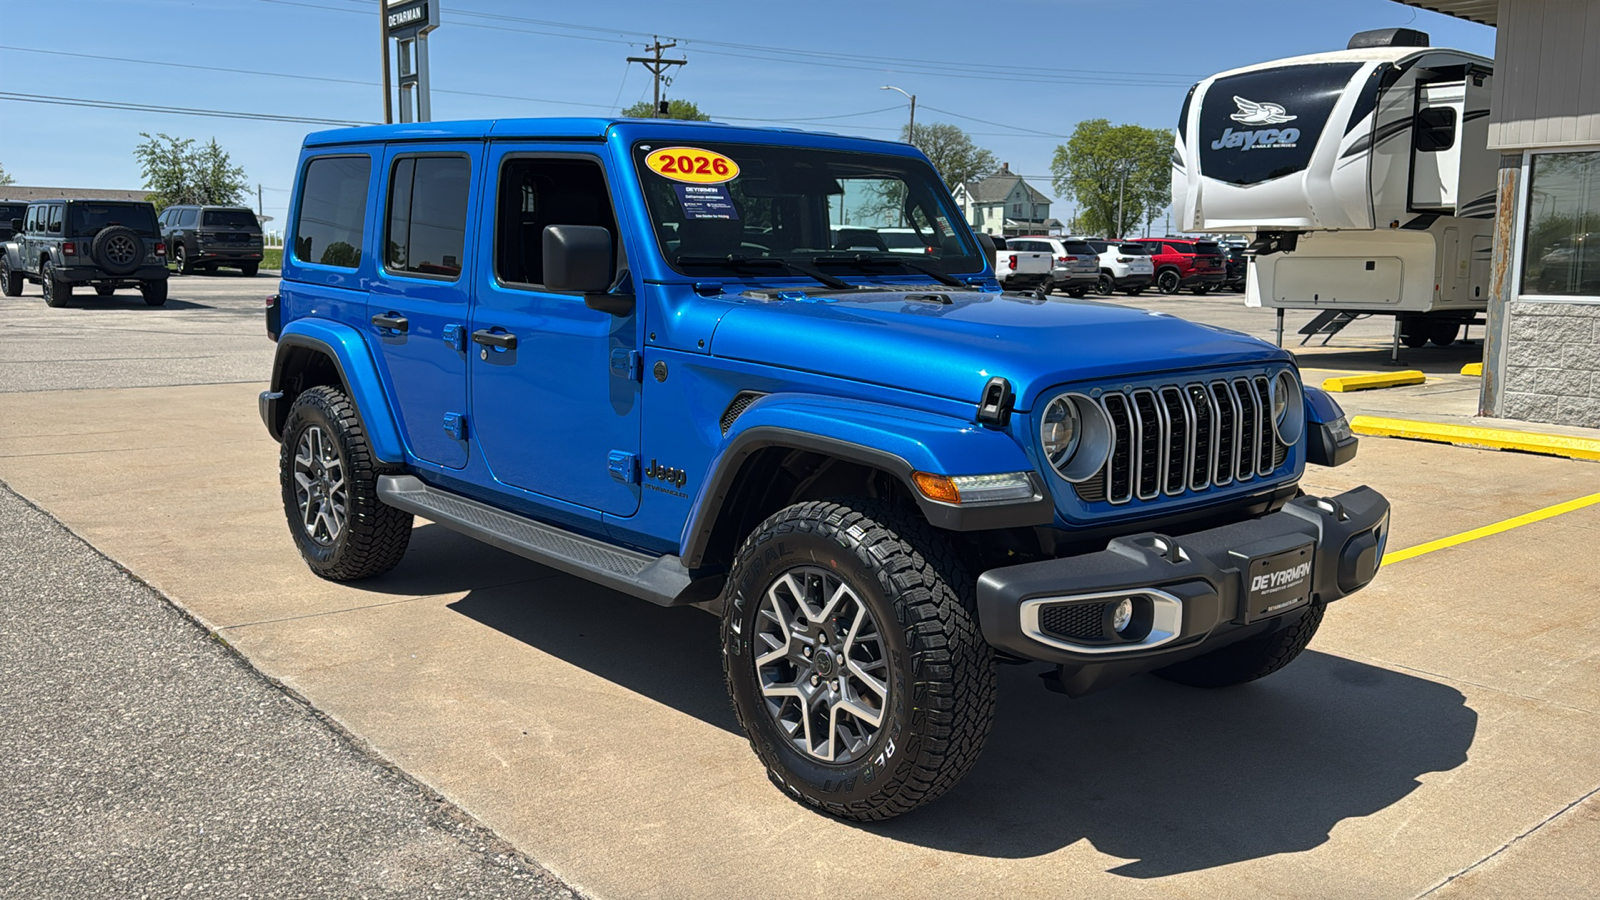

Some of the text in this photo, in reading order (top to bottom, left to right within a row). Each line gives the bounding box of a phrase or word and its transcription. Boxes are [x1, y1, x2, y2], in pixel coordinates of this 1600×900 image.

[388, 6, 421, 27] DEYARMAN
[1211, 127, 1300, 152] Jayco
[659, 155, 729, 176] 2026
[645, 458, 687, 489] Jeep
[1250, 561, 1312, 592] DEYARMAN
